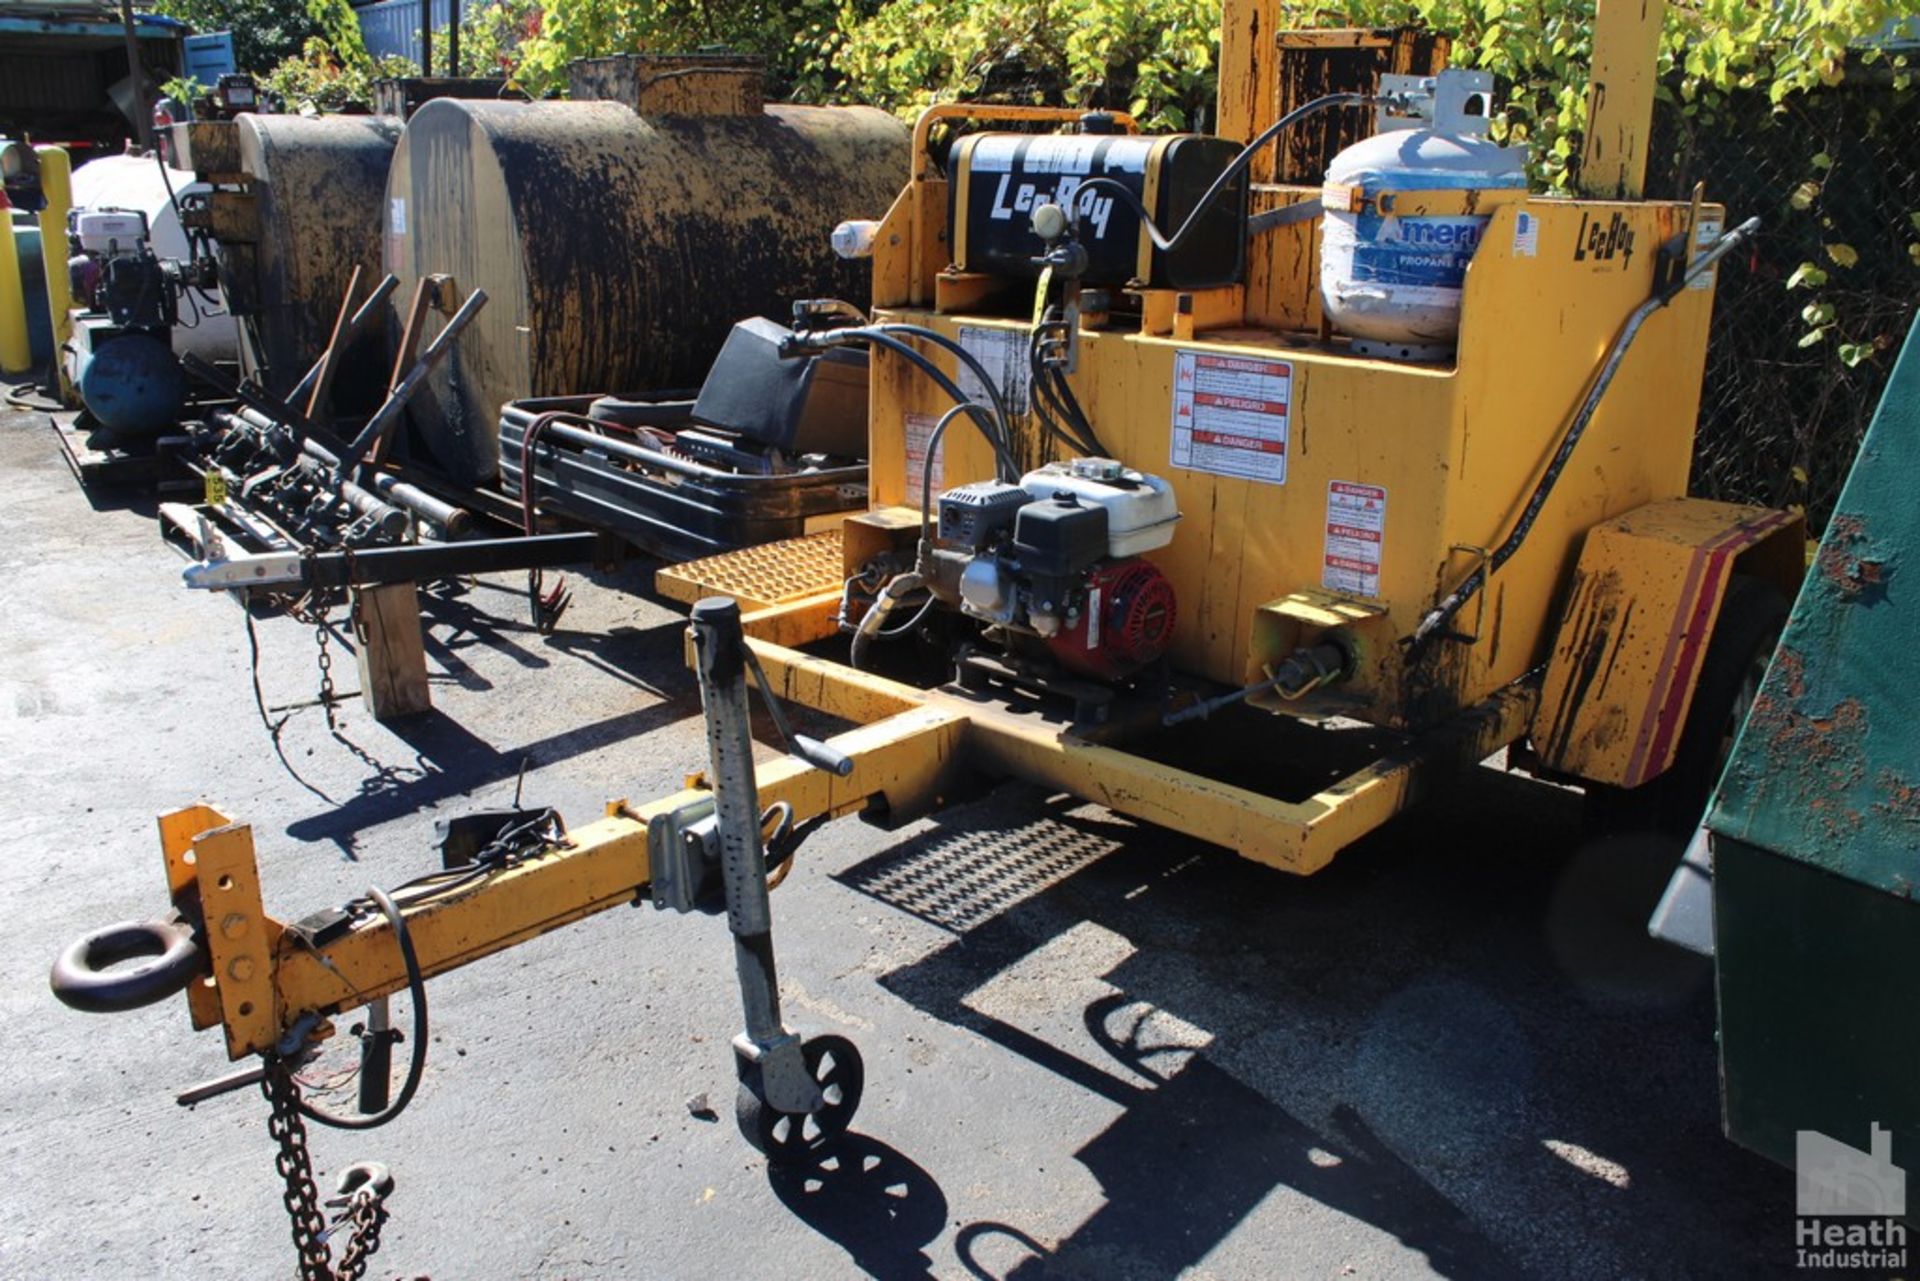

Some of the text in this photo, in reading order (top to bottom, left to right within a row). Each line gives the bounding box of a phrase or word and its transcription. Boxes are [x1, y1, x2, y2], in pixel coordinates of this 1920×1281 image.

[1227, 360, 1267, 373] DANGER
[1223, 397, 1266, 412] PELIGRO
[1222, 435, 1263, 450] DANGER
